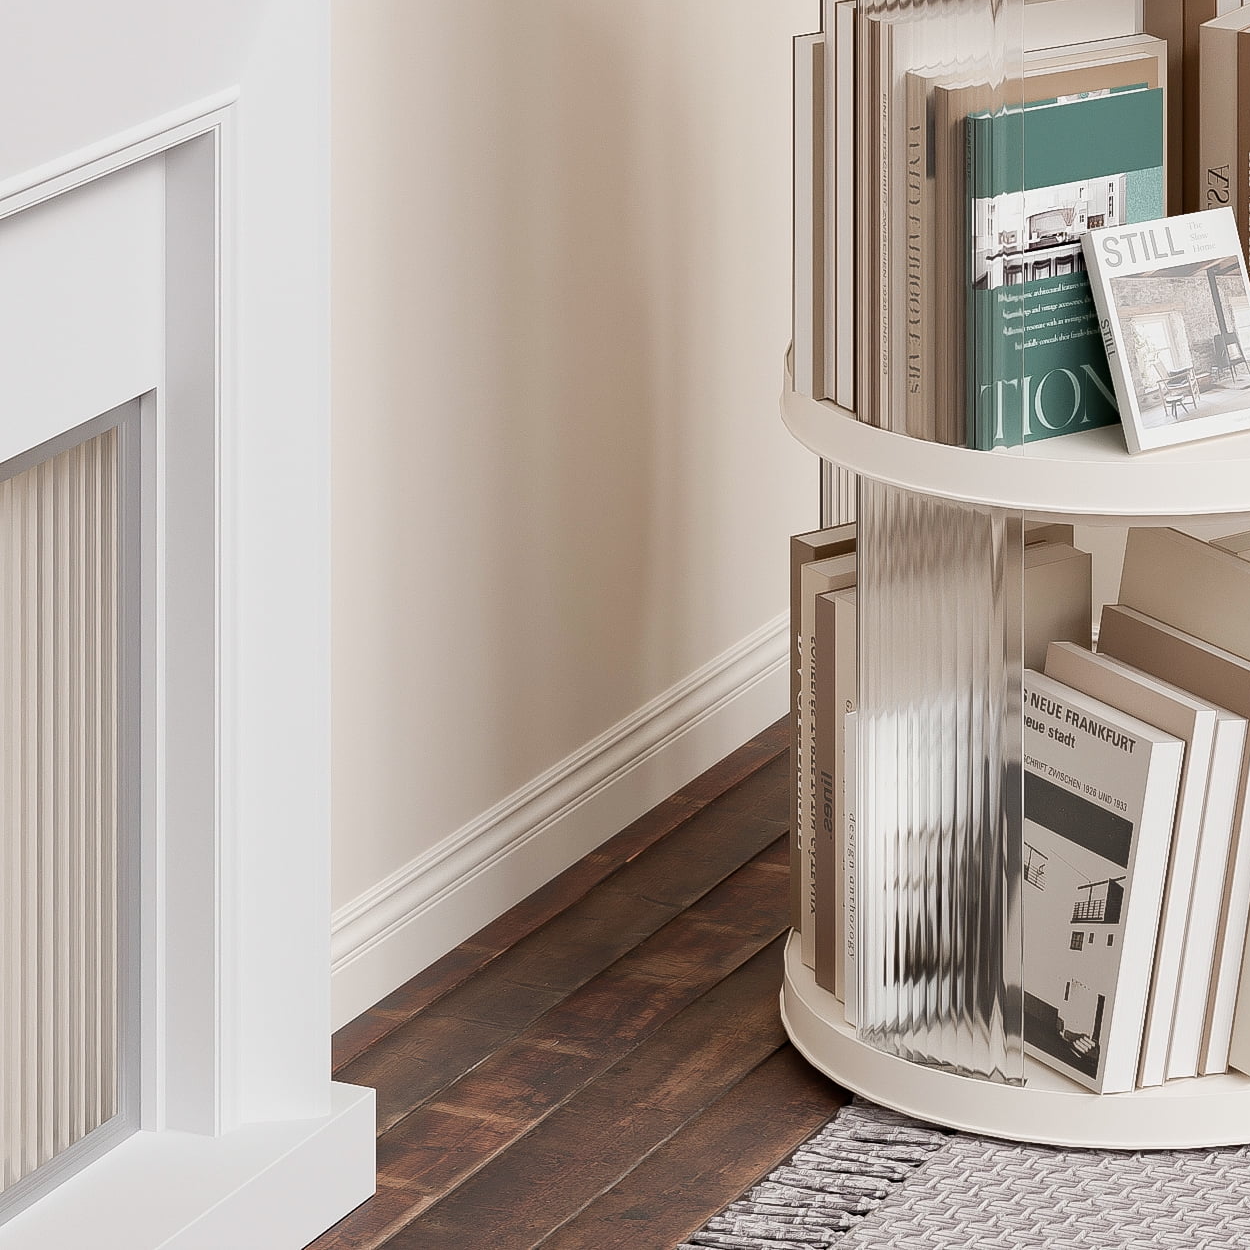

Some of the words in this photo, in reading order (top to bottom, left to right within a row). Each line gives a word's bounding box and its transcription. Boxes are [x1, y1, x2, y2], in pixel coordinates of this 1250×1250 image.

[1102, 226, 1185, 268] STILL
[1187, 221, 1203, 231] The
[1190, 231, 1208, 241] Slow
[1193, 242, 1217, 253] Home
[1100, 318, 1117, 361] STILL
[1030, 692, 1063, 720] NEUE
[1065, 708, 1137, 755] FRANKFURT
[1047, 726, 1077, 749] stadt
[1047, 766, 1083, 790] ZWISCHEN
[1083, 783, 1098, 798] 1926
[1098, 789, 1113, 806] UND
[1113, 797, 1128, 813] 1933
[847, 812, 856, 870] design
